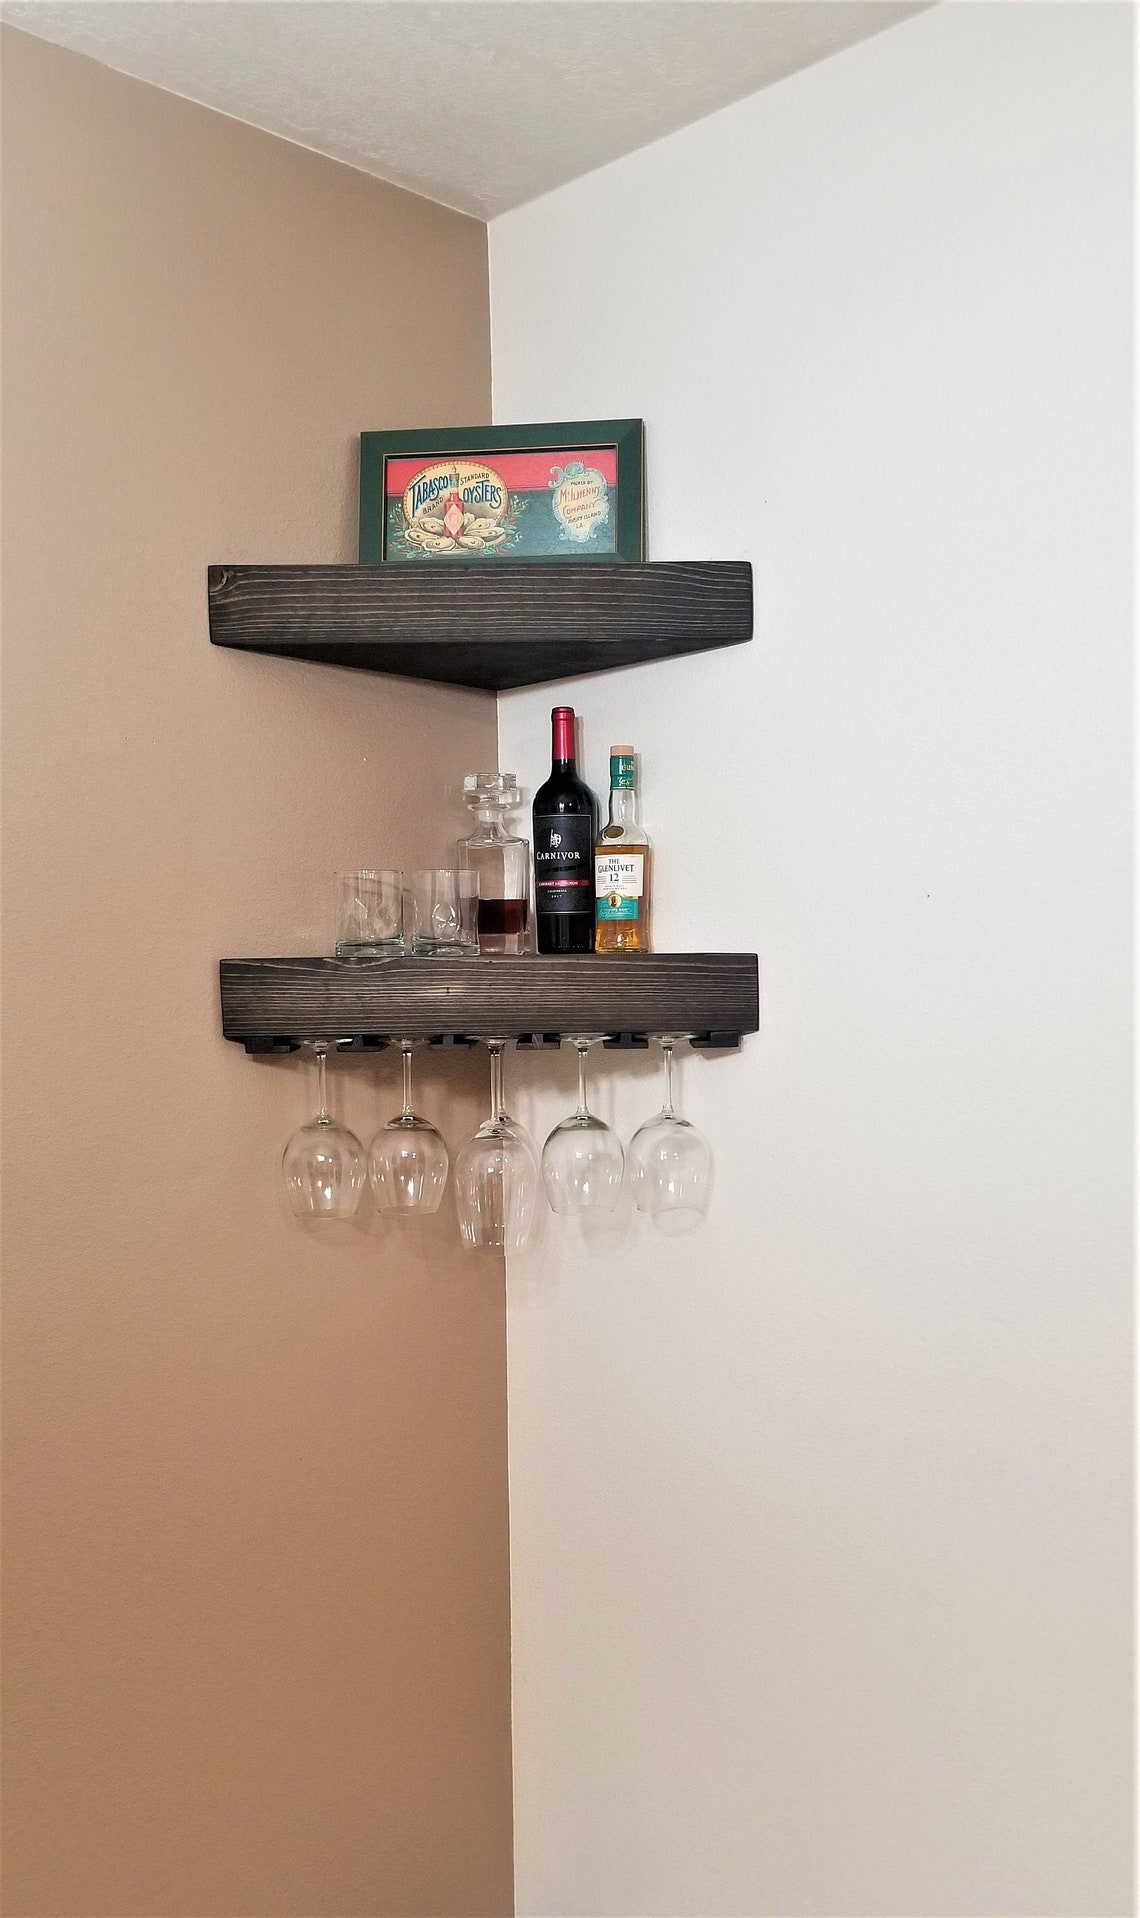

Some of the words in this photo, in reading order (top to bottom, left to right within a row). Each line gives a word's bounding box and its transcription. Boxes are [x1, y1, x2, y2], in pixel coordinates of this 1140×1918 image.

[460, 472, 490, 486] STANDARD
[409, 475, 449, 518] TABASCO
[463, 480, 502, 509] OYSTERS
[422, 497, 444, 514] BRAND
[536, 851, 580, 860] CARNIVOR
[597, 864, 635, 873] GLENLIVET
[610, 873, 620, 882] 12
